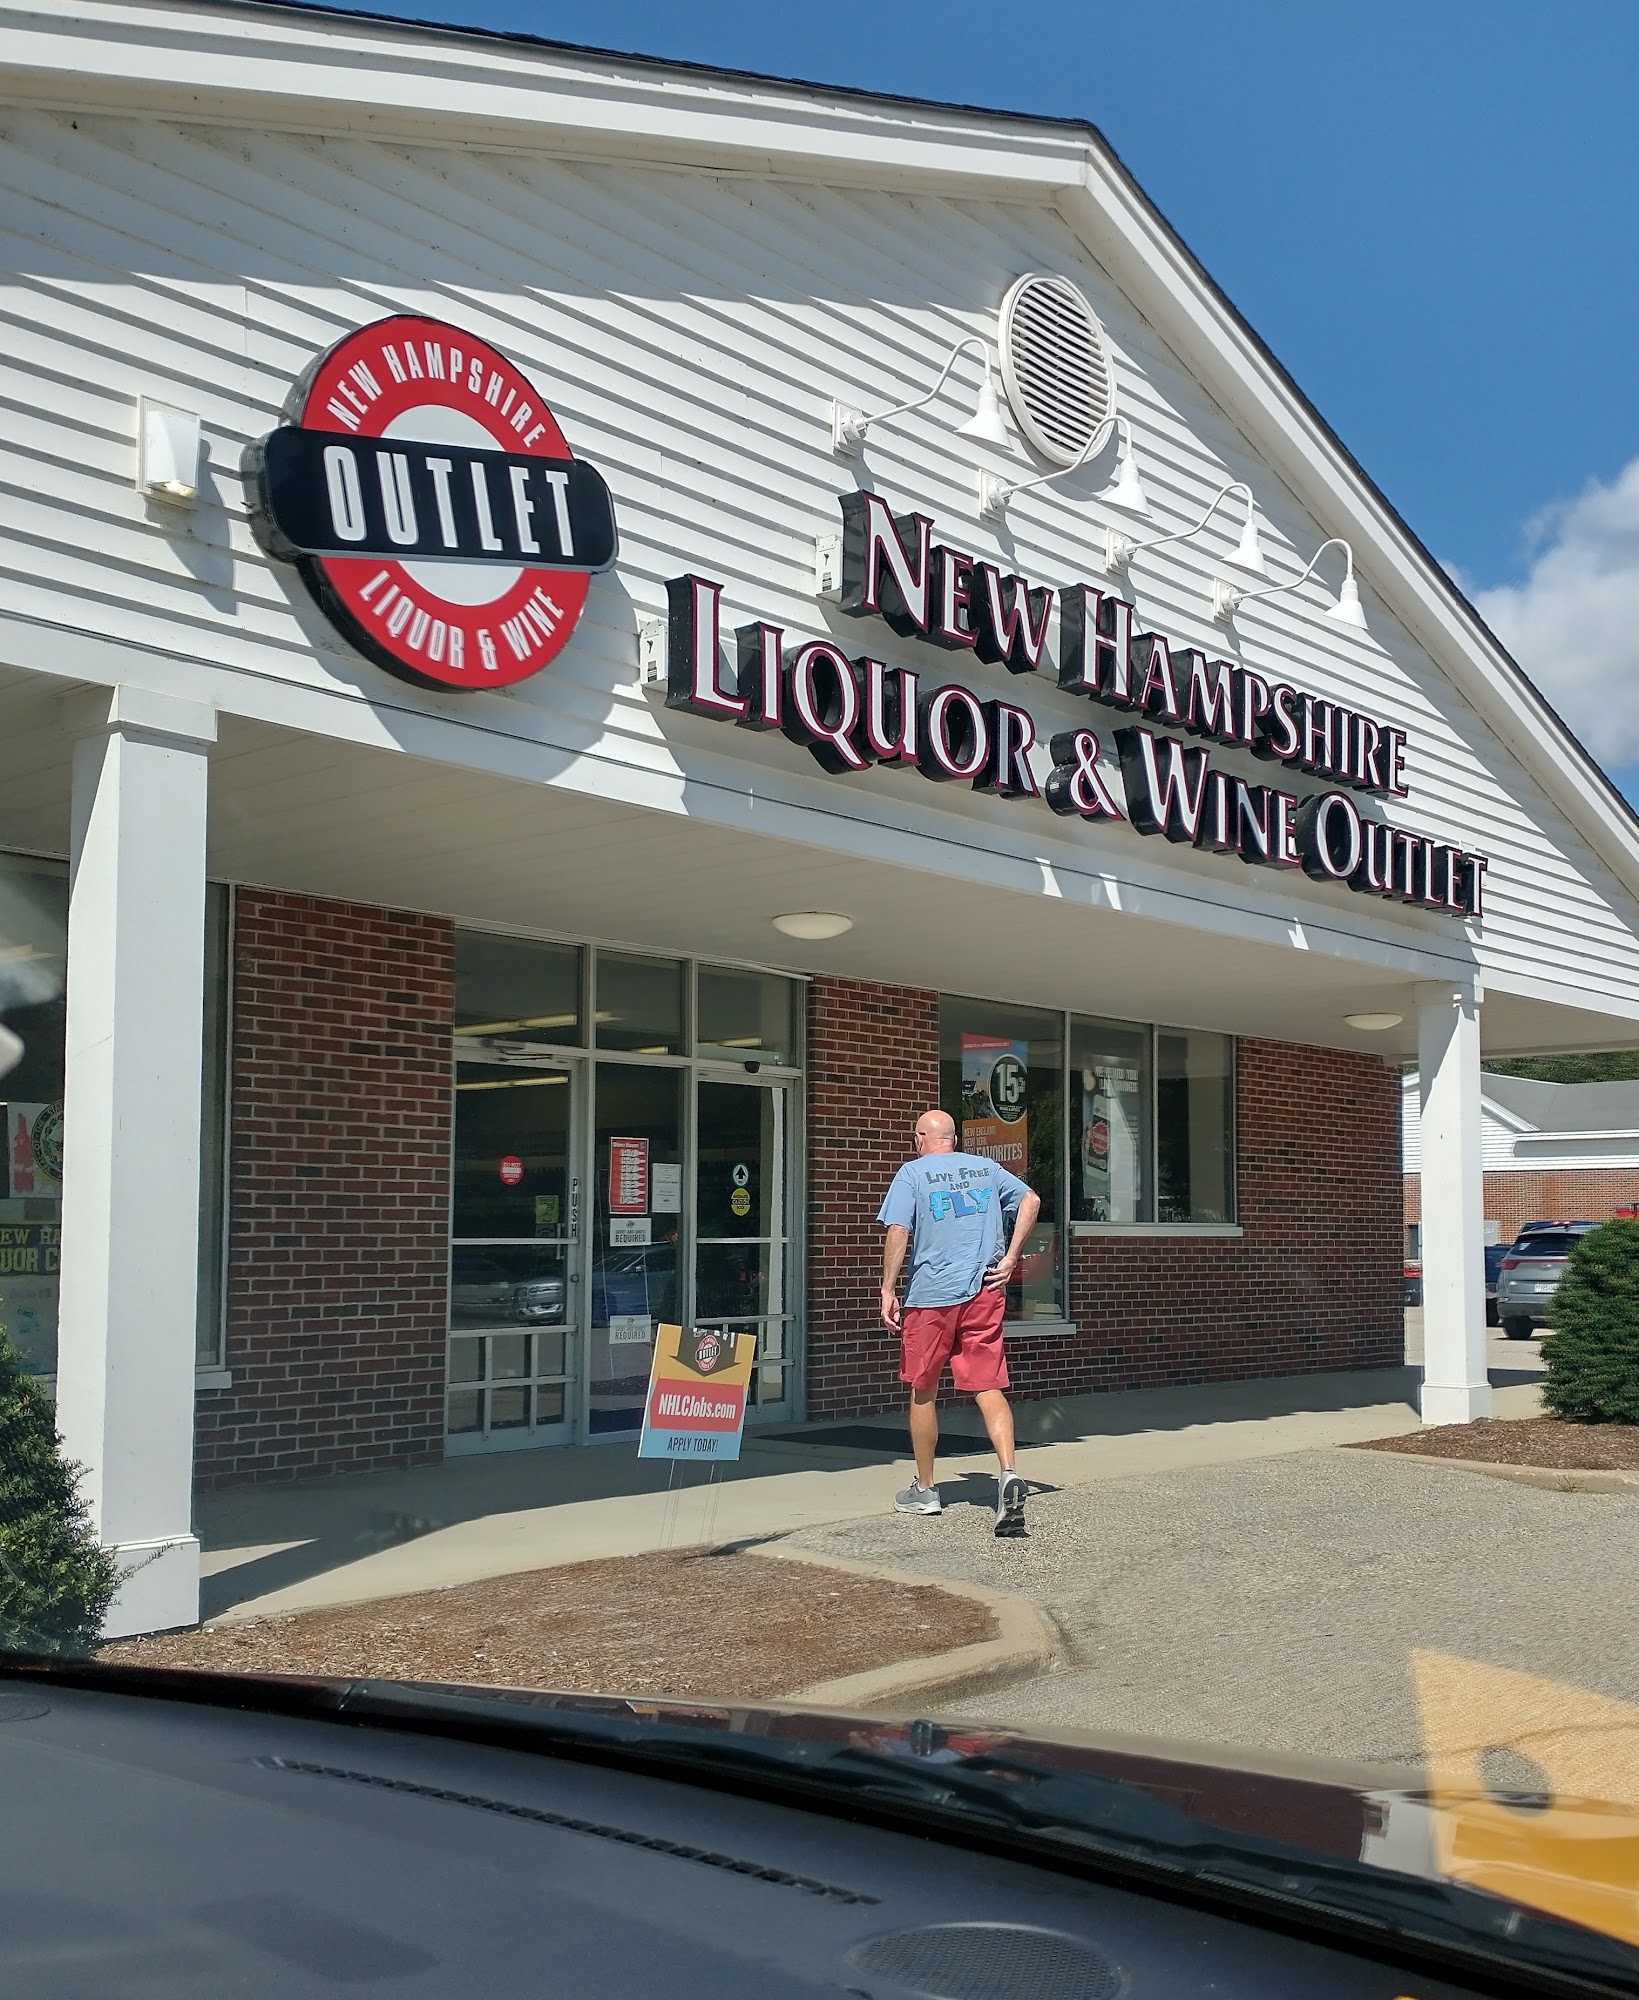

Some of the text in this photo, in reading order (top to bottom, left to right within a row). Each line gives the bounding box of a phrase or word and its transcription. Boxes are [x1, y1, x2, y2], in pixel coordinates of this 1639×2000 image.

[326, 341, 547, 449] NEW HAMPSHIRE
[323, 445, 575, 557] OUTLET
[358, 569, 564, 671] LIQUOR & WINE
[862, 490, 1410, 799] NEW HAMPSHIRE
[690, 575, 1489, 918] LIQUOR & WINE OUTLET
[963, 1126, 997, 1138] NEW ENGLAND
[963, 1137, 976, 1147] NEW
[976, 1143, 1023, 1162] FAVORITES
[925, 1167, 990, 1184] LIVE FREE
[949, 1181, 970, 1191] AND
[929, 1185, 993, 1223] FLY
[0, 1228, 31, 1245] EW
[615, 1234, 647, 1243] REQUIRED
[615, 1331, 646, 1340] REQUIRED
[658, 1393, 736, 1419] NHLCJobs.com
[667, 1436, 719, 1453] APPLY TODAY!
